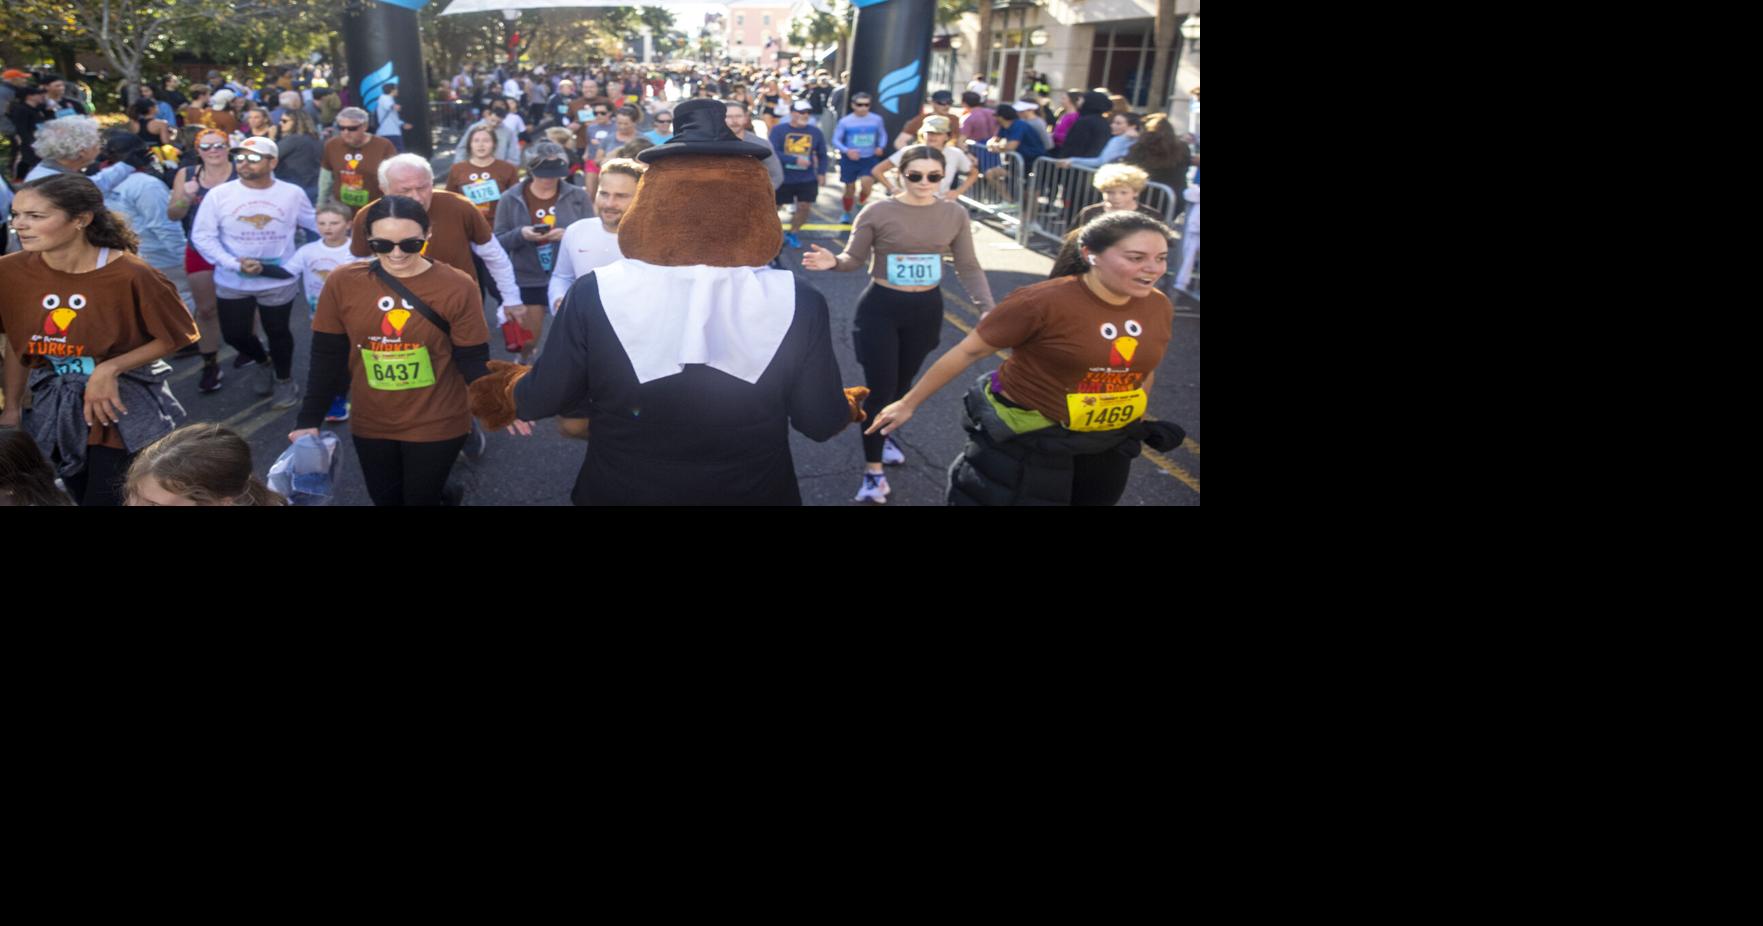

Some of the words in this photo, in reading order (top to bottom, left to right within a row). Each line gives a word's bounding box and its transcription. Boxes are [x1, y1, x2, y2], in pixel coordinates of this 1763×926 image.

[896, 263, 933, 279] 2101
[28, 341, 85, 357] TURKEY
[373, 362, 420, 381] 6437
[1085, 404, 1134, 426] 1469
